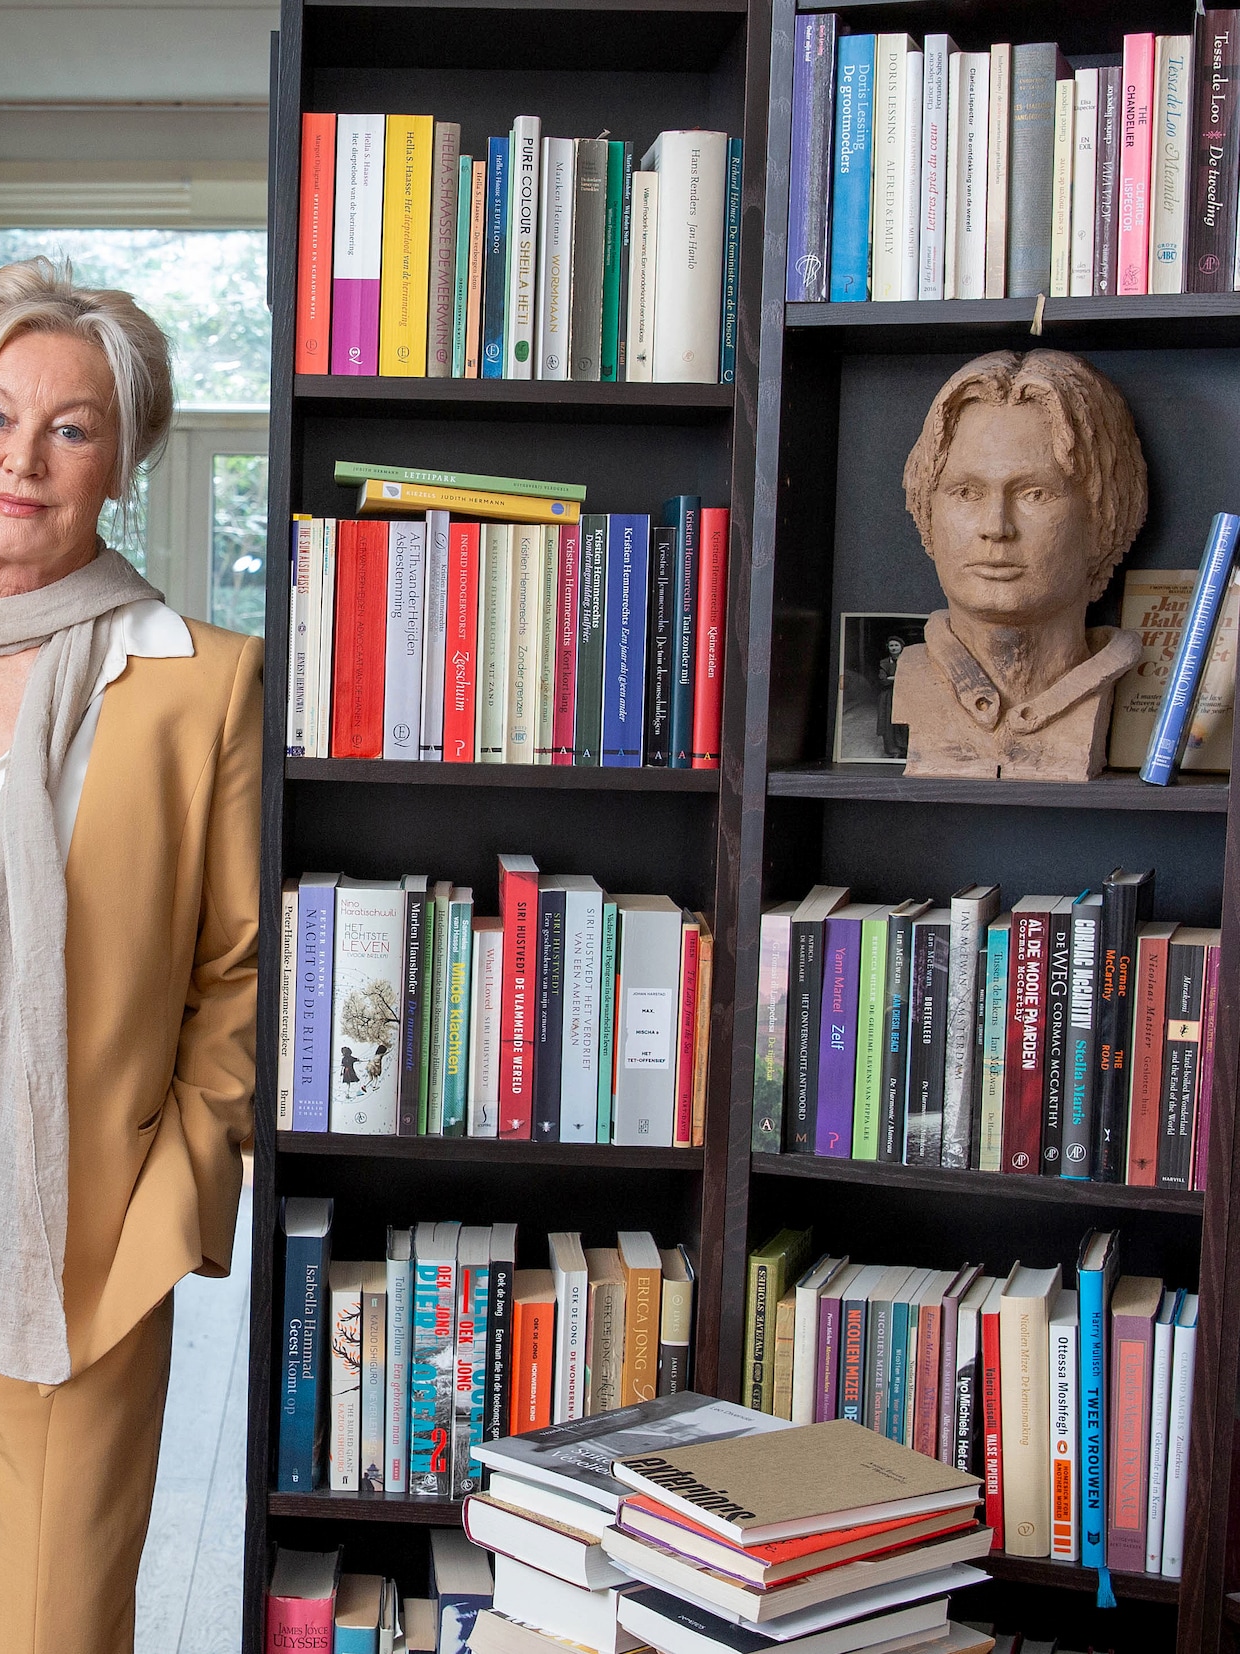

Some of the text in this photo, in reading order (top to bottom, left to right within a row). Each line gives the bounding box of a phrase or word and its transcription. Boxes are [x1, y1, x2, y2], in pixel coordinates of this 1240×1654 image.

[889, 53, 897, 91] DORIS
[968, 68, 976, 91] Clarice
[840, 65, 854, 173] De grootmoeders
[853, 64, 869, 150] Doris Lessing
[887, 96, 896, 144] LESSING
[967, 93, 975, 125] Lispector
[1125, 85, 1136, 148] CHANDELIER
[1139, 106, 1147, 125] THE
[1204, 32, 1229, 226] Tessa de Loo De tweeling
[967, 133, 974, 142] De
[1163, 56, 1184, 214] Tessa de Loo Meander
[349, 147, 358, 185] dieptelood
[885, 160, 895, 206] ALFRED
[926, 122, 938, 232] Lettres près du cœur
[966, 144, 974, 183] ontdekking
[350, 201, 356, 210] de
[687, 149, 700, 269] Hans Renders Jan Hanlo
[966, 199, 973, 208] de
[1123, 178, 1133, 232] LISPECTOR
[1135, 182, 1145, 226] CLARICE
[348, 212, 356, 255] herinnering
[518, 138, 533, 325] PURE COLOUR SHEILA HETI
[549, 162, 564, 332] Mariken Heitman WORMMAAN
[725, 157, 740, 348] Richard Holmes De feministe en de filosoof
[884, 220, 894, 255] EMILY
[1160, 251, 1176, 260] ABC
[404, 471, 456, 484] LETTIPARK
[406, 490, 506, 506] KIEZELS JUDITH HERMANN
[391, 532, 405, 618] Asbestemming
[679, 510, 694, 684] Kristien Hemmerechts Taal zonder mij
[452, 534, 470, 711] INGRID HOOGERVORST Zeeschuim
[341, 899, 360, 908] Nino
[344, 923, 364, 932] HET
[342, 940, 390, 952] LEVEN
[344, 932, 388, 940] ACHTSTE
[1014, 919, 1027, 1022] Cormac McCarthy
[1022, 919, 1041, 1069] AL DE MOOIE PAARDEN
[1102, 950, 1116, 1001] McCarthy
[1118, 956, 1130, 996] Cormac
[302, 910, 317, 1085] NACHT OP DE RIVIER
[448, 962, 465, 1074] Milde klachten
[512, 902, 527, 1094] SIRI HUSTVEDT DE VLAMMENDE WERELD
[831, 948, 846, 1051] Yann Martel Zelf
[1070, 919, 1095, 1125] CORMAC McCARTHY Stella Maris
[797, 993, 809, 1120] HET ONVERWACHTE ANTWOORD
[1101, 1044, 1110, 1070] ROAD
[1114, 1050, 1124, 1069] THE
[1167, 1050, 1179, 1135] and the End of the World
[1179, 1050, 1192, 1136] Hard-boiled Wonderland
[302, 1265, 318, 1379] Isabella Hammad
[633, 1277, 650, 1370] ERICA JONG
[284, 1319, 302, 1415] Geest komt op
[845, 1310, 861, 1400] NICOLIEN MIZEE
[1055, 1337, 1069, 1435] Ottessa Moshfegh
[1087, 1312, 1102, 1509] Harry Mulisch TWEE VROUWEN
[337, 1403, 345, 1473] KAZUO ISHIGURO
[346, 1420, 354, 1448] BURIED
[571, 1448, 610, 1463] Suite
[985, 1368, 998, 1494] Valeria Luiselli VALSE PAPIEREN
[1153, 1432, 1162, 1469] Gekromde
[1152, 1472, 1161, 1485] tijd
[1151, 1496, 1160, 1520] Krems
[273, 1634, 328, 1648] ULYSSES
[278, 1622, 328, 1638] JAMES JOYCE
